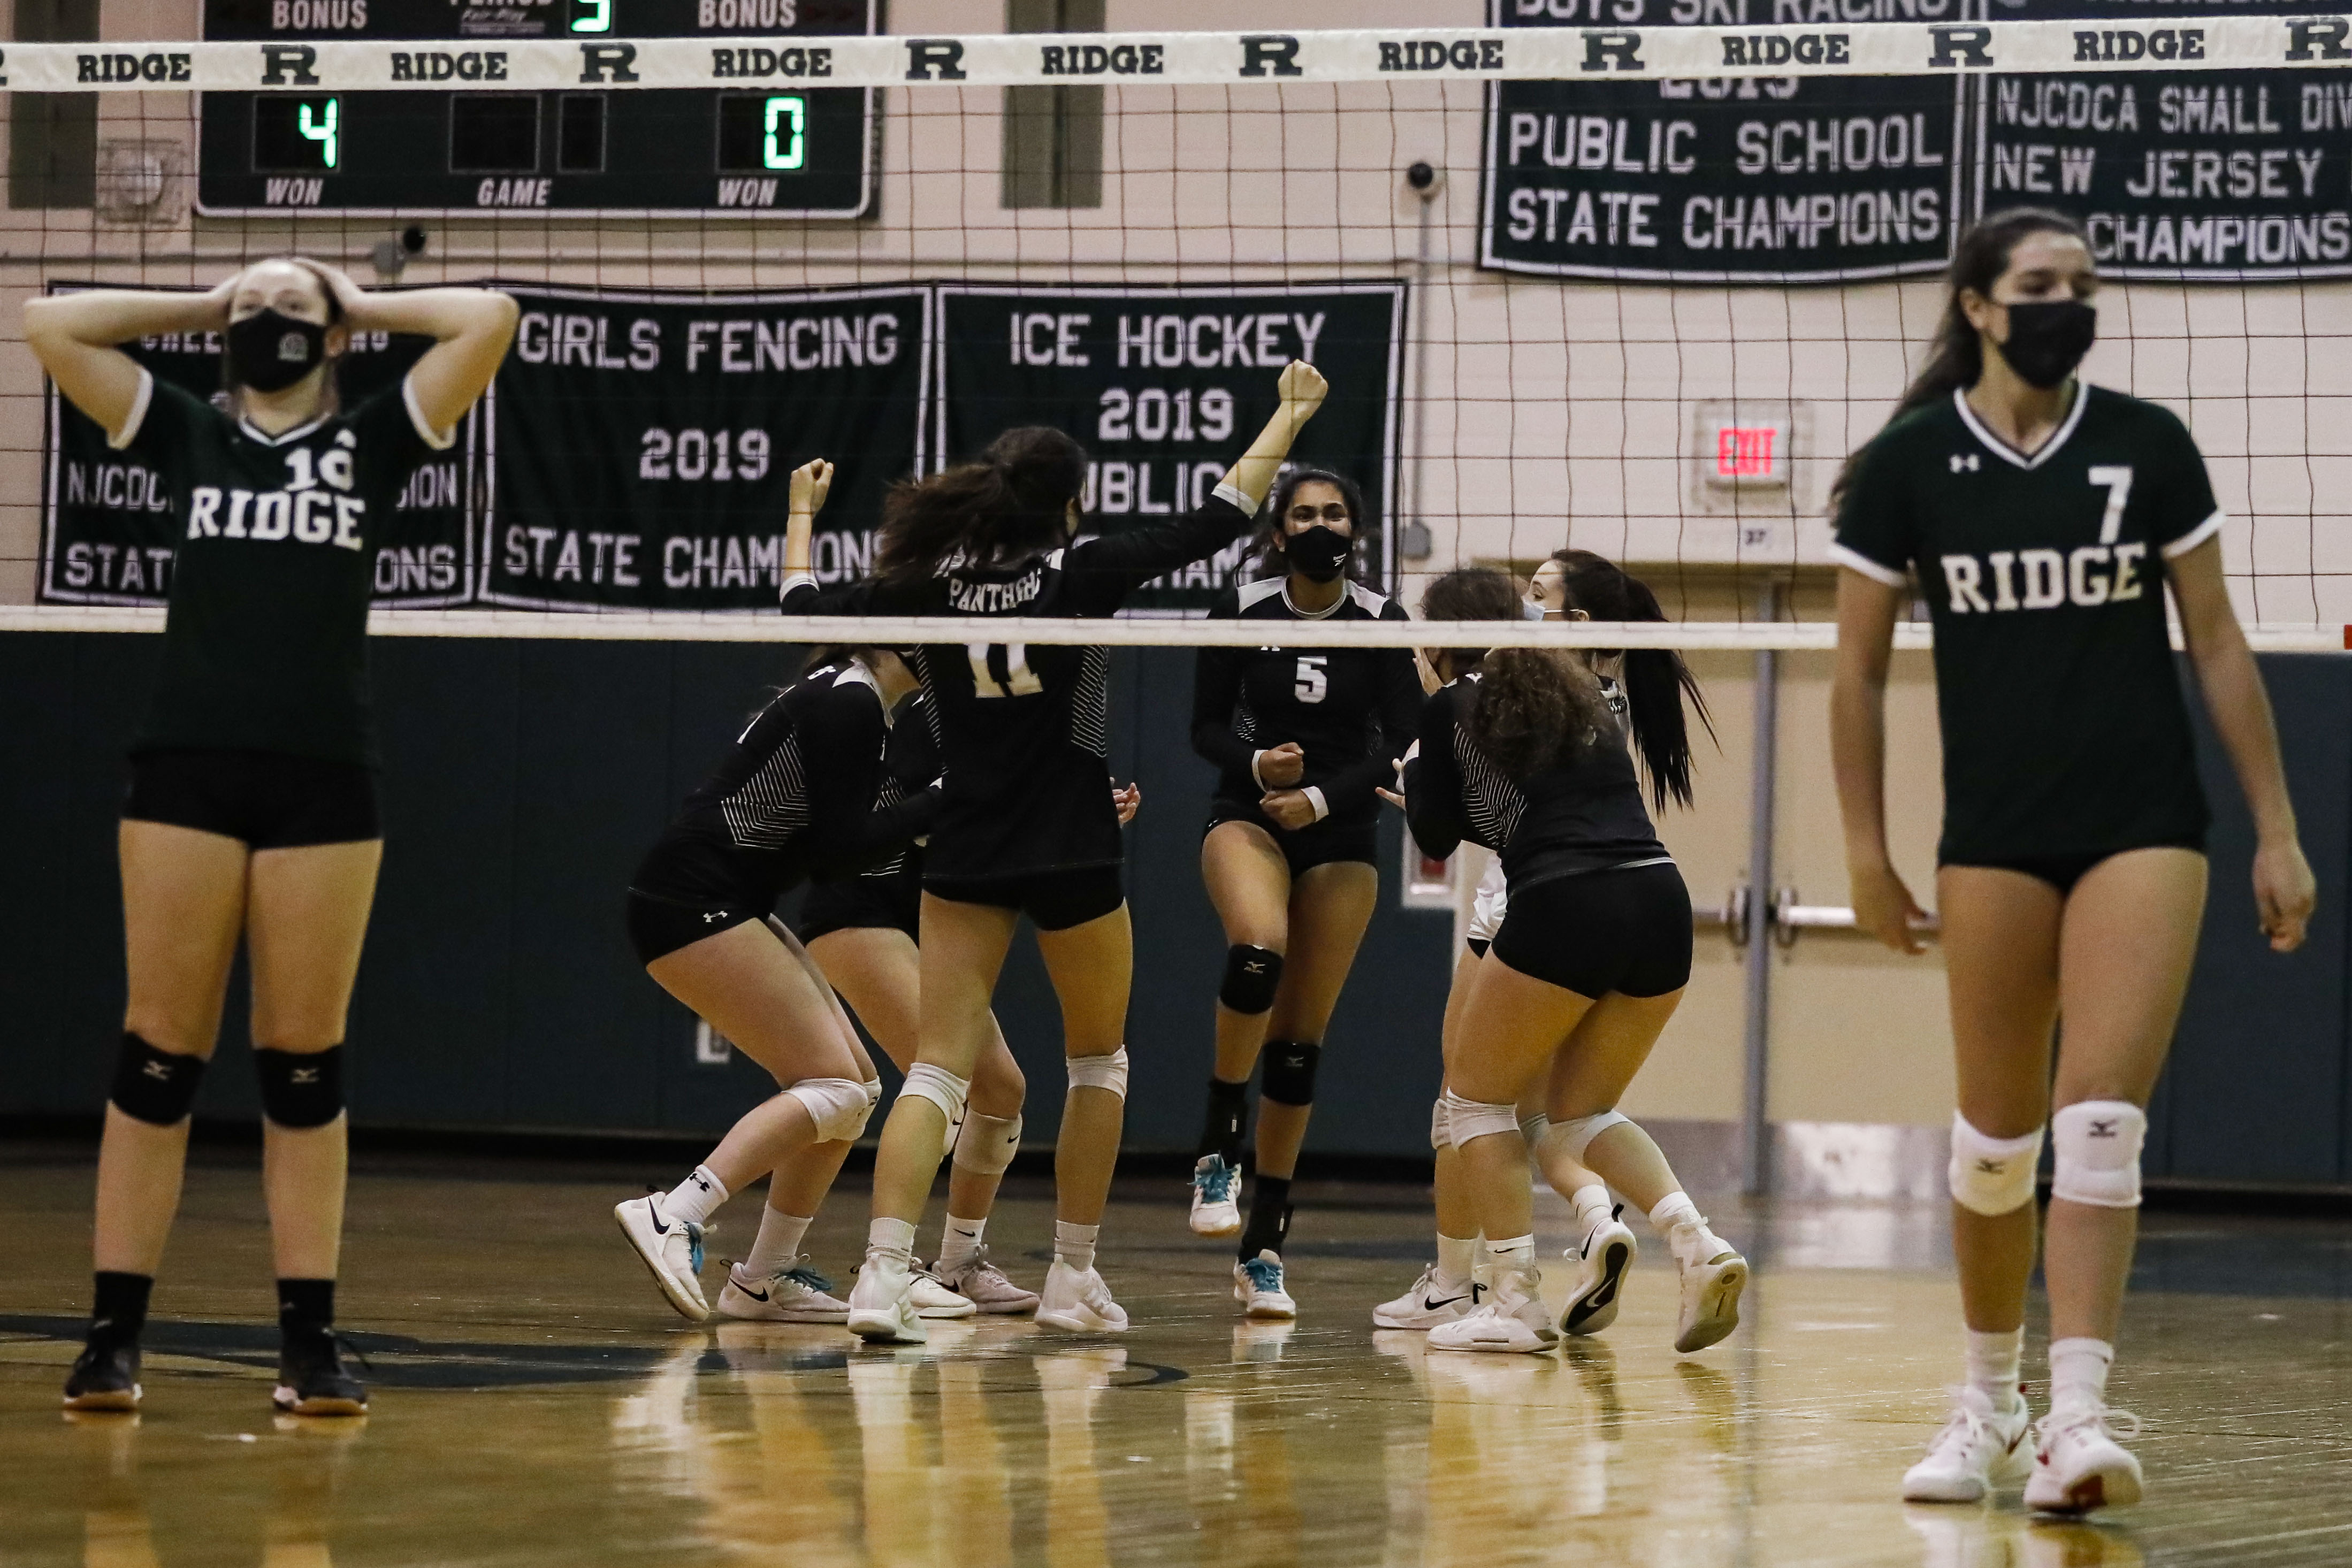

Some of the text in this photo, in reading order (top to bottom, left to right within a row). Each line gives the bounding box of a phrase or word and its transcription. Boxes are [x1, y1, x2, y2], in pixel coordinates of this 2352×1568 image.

[272, 0, 367, 29] BONUS
[698, 0, 797, 28] BONUS
[77, 17, 2352, 85] RIDGE R RIDGE R RIDGE R RIDGE R RIDGE R RIDGE R RIDGE R
[299, 98, 337, 167] 4
[764, 97, 805, 169] 0
[2159, 85, 2280, 134] SMALL
[1509, 113, 1944, 174] PUBLIC SCHOOL
[1992, 143, 2323, 198] NEW JERSEY
[266, 178, 323, 205] WON
[477, 179, 552, 206] GAME
[717, 179, 778, 206] WON
[1508, 188, 1941, 249] STATE CHAMPIONS
[2088, 212, 2351, 264] CHAMPIONS
[517, 312, 899, 372] GIRLS FENCING
[1010, 312, 1326, 368] ICE HOCKEY
[1098, 388, 1234, 441] 2019
[639, 428, 770, 481] 2019
[1718, 427, 1778, 475] EXIT
[187, 486, 366, 552] RIDGE
[2088, 465, 2134, 545] 7
[64, 541, 175, 591] STAT
[505, 526, 641, 587] STATE
[1941, 542, 2147, 613] RIDGE
[1295, 655, 1328, 703] 5
